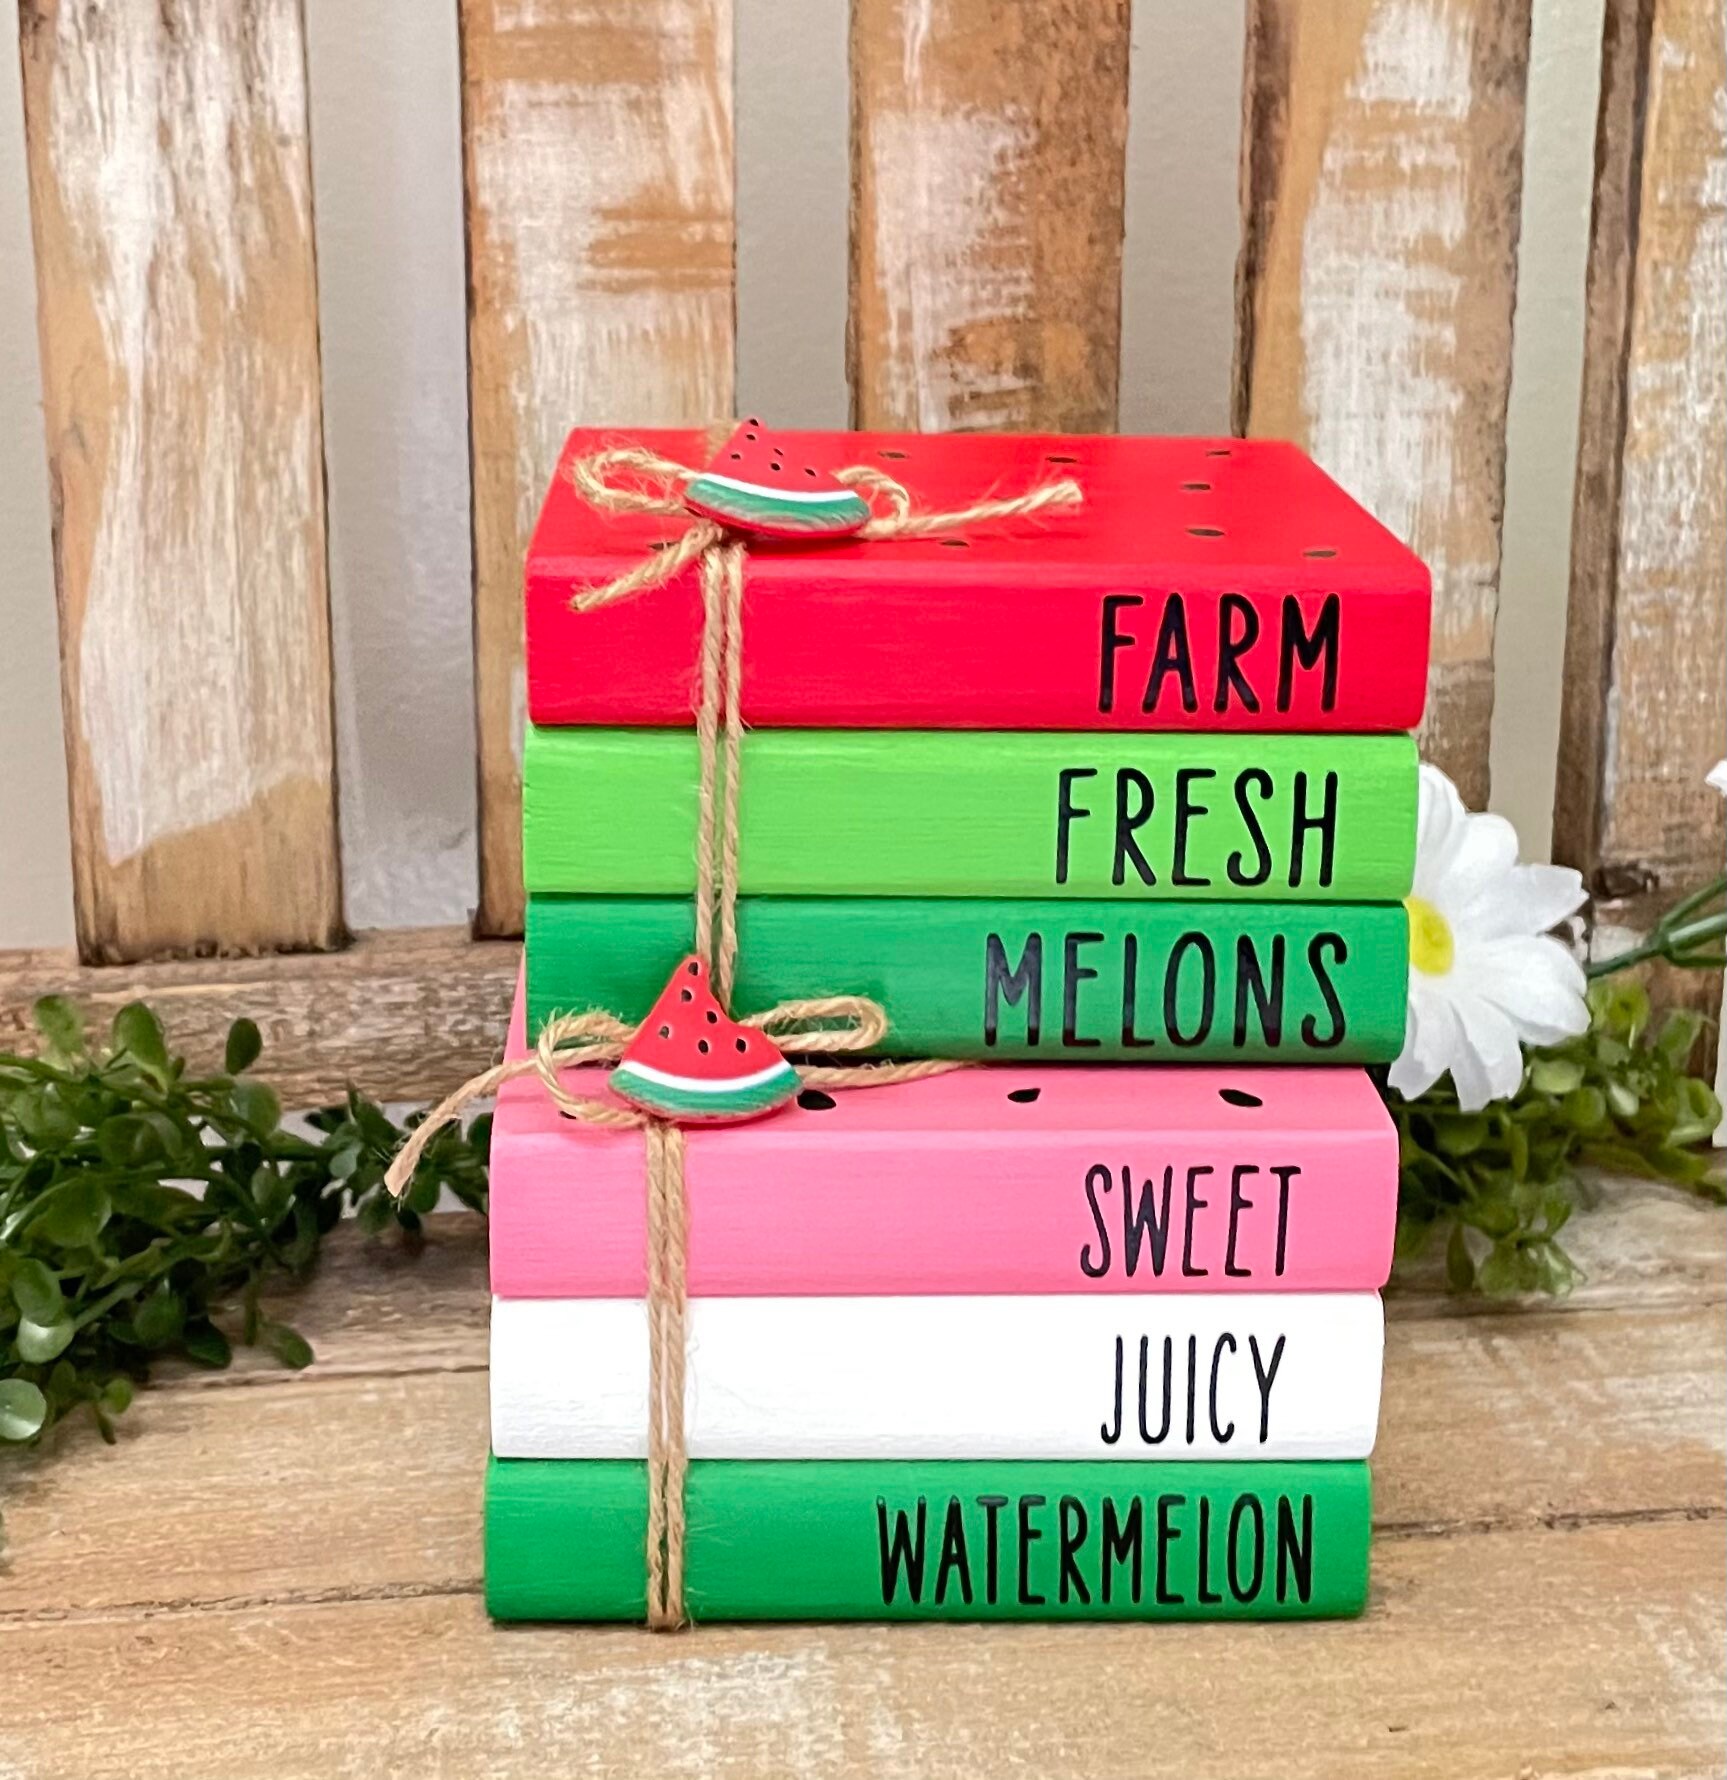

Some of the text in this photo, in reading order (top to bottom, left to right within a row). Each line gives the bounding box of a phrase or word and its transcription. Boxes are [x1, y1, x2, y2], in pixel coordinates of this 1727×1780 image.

[1099, 593, 1341, 713] FARM
[1056, 768, 1339, 887] FRESH
[984, 932, 1347, 1048] MELONS
[1081, 1164, 1301, 1278] SWEET
[1101, 1332, 1286, 1445] JUICY
[876, 1493, 1314, 1606] WATERMELON
